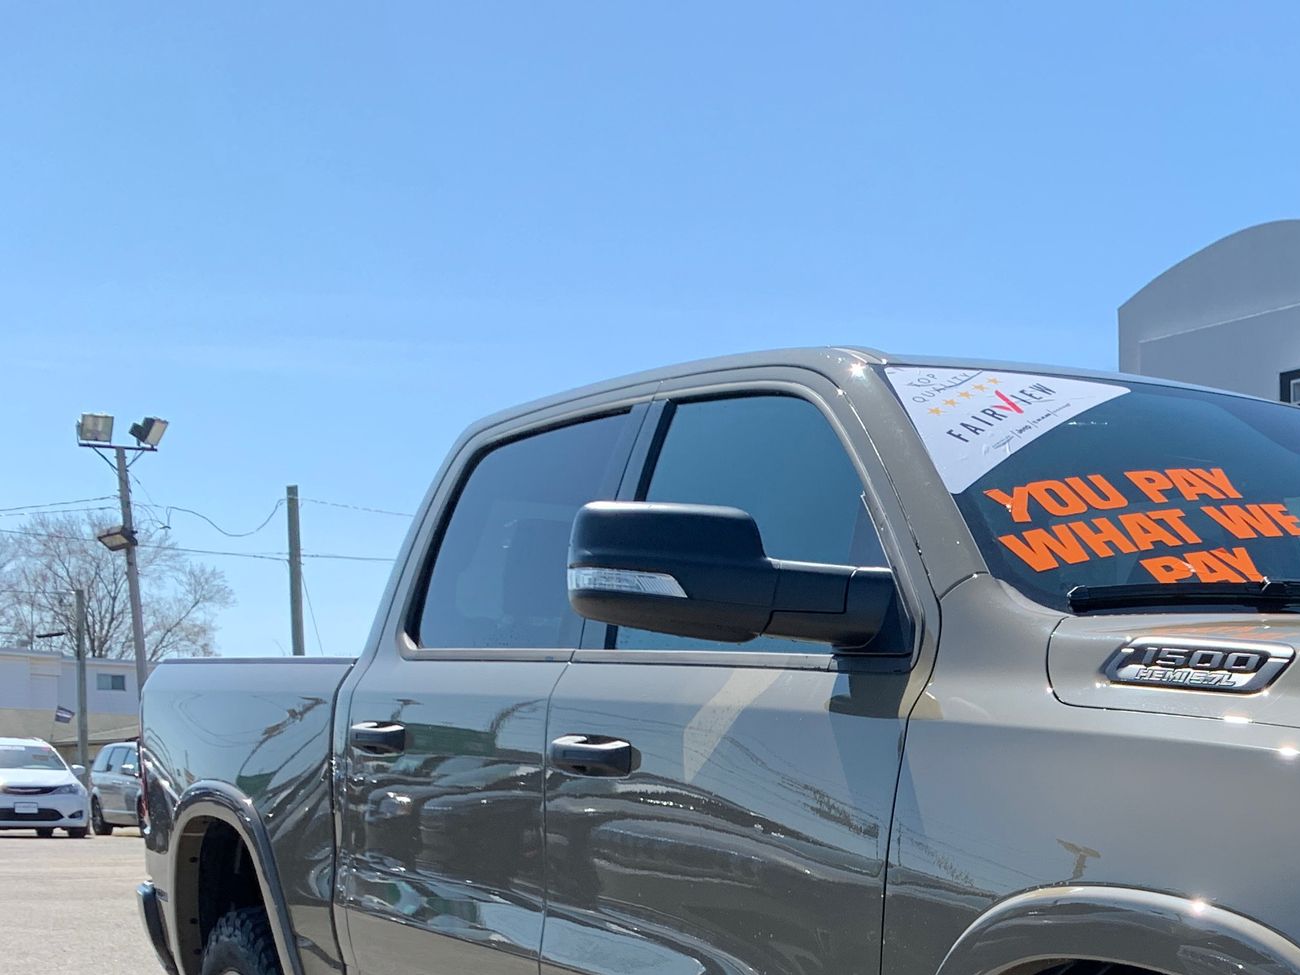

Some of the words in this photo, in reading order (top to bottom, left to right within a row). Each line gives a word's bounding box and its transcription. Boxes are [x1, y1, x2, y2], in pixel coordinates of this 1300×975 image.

[912, 372, 970, 403] QUALITY
[947, 383, 1056, 442] FAIRVIEW
[983, 474, 1129, 523] YOU
[1123, 467, 1243, 504] PAY
[998, 508, 1201, 573] WHAT
[1139, 547, 1264, 584] PAY
[1135, 667, 1188, 684] HEMI
[1189, 670, 1237, 687] 5.7L
[1142, 647, 1260, 671] 1500
